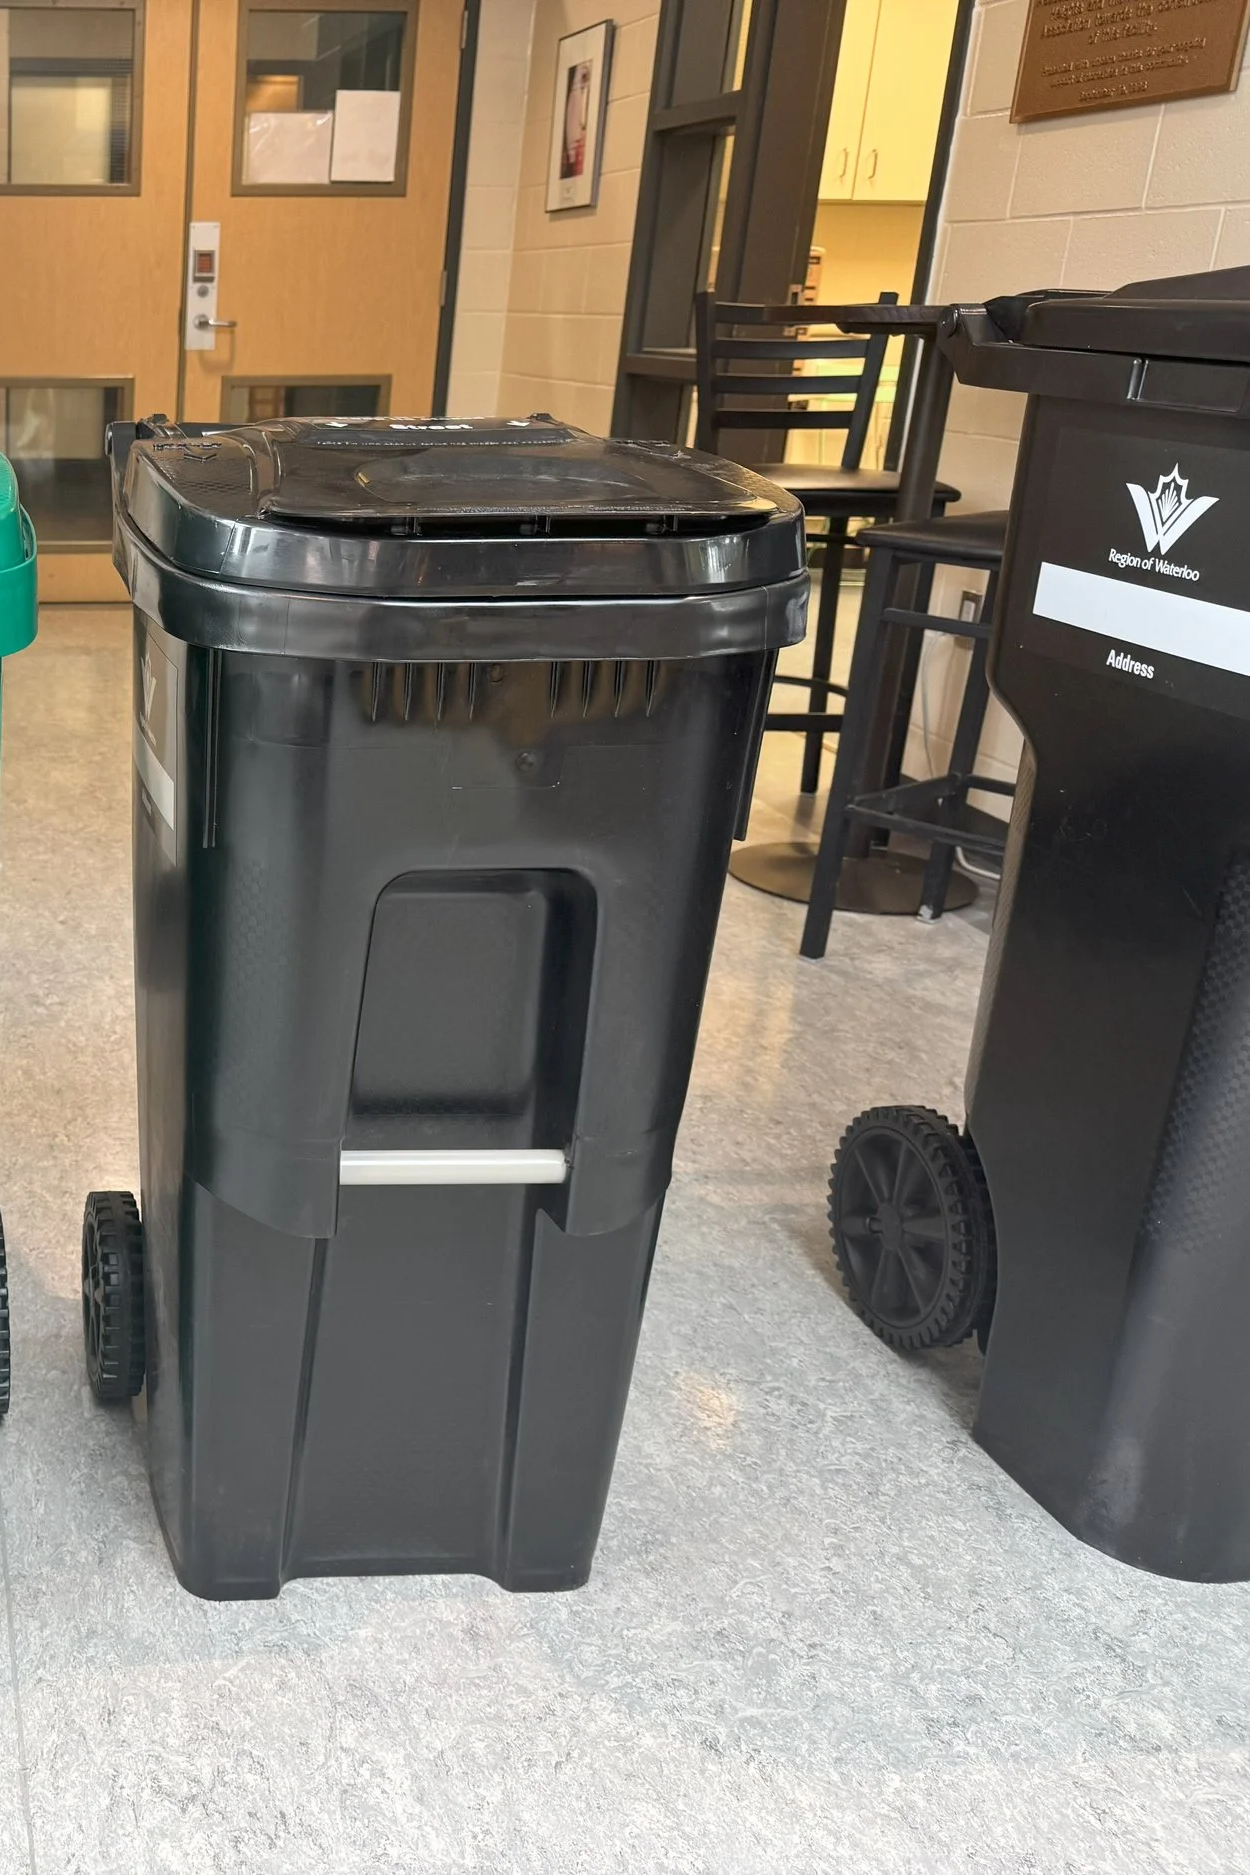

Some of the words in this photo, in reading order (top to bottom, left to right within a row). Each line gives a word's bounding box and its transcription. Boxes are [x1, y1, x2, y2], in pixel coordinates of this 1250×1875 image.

[1108, 548, 1141, 569] Region
[1141, 557, 1154, 571] of
[1155, 558, 1200, 582] Waterloo
[1106, 649, 1155, 679] Address
